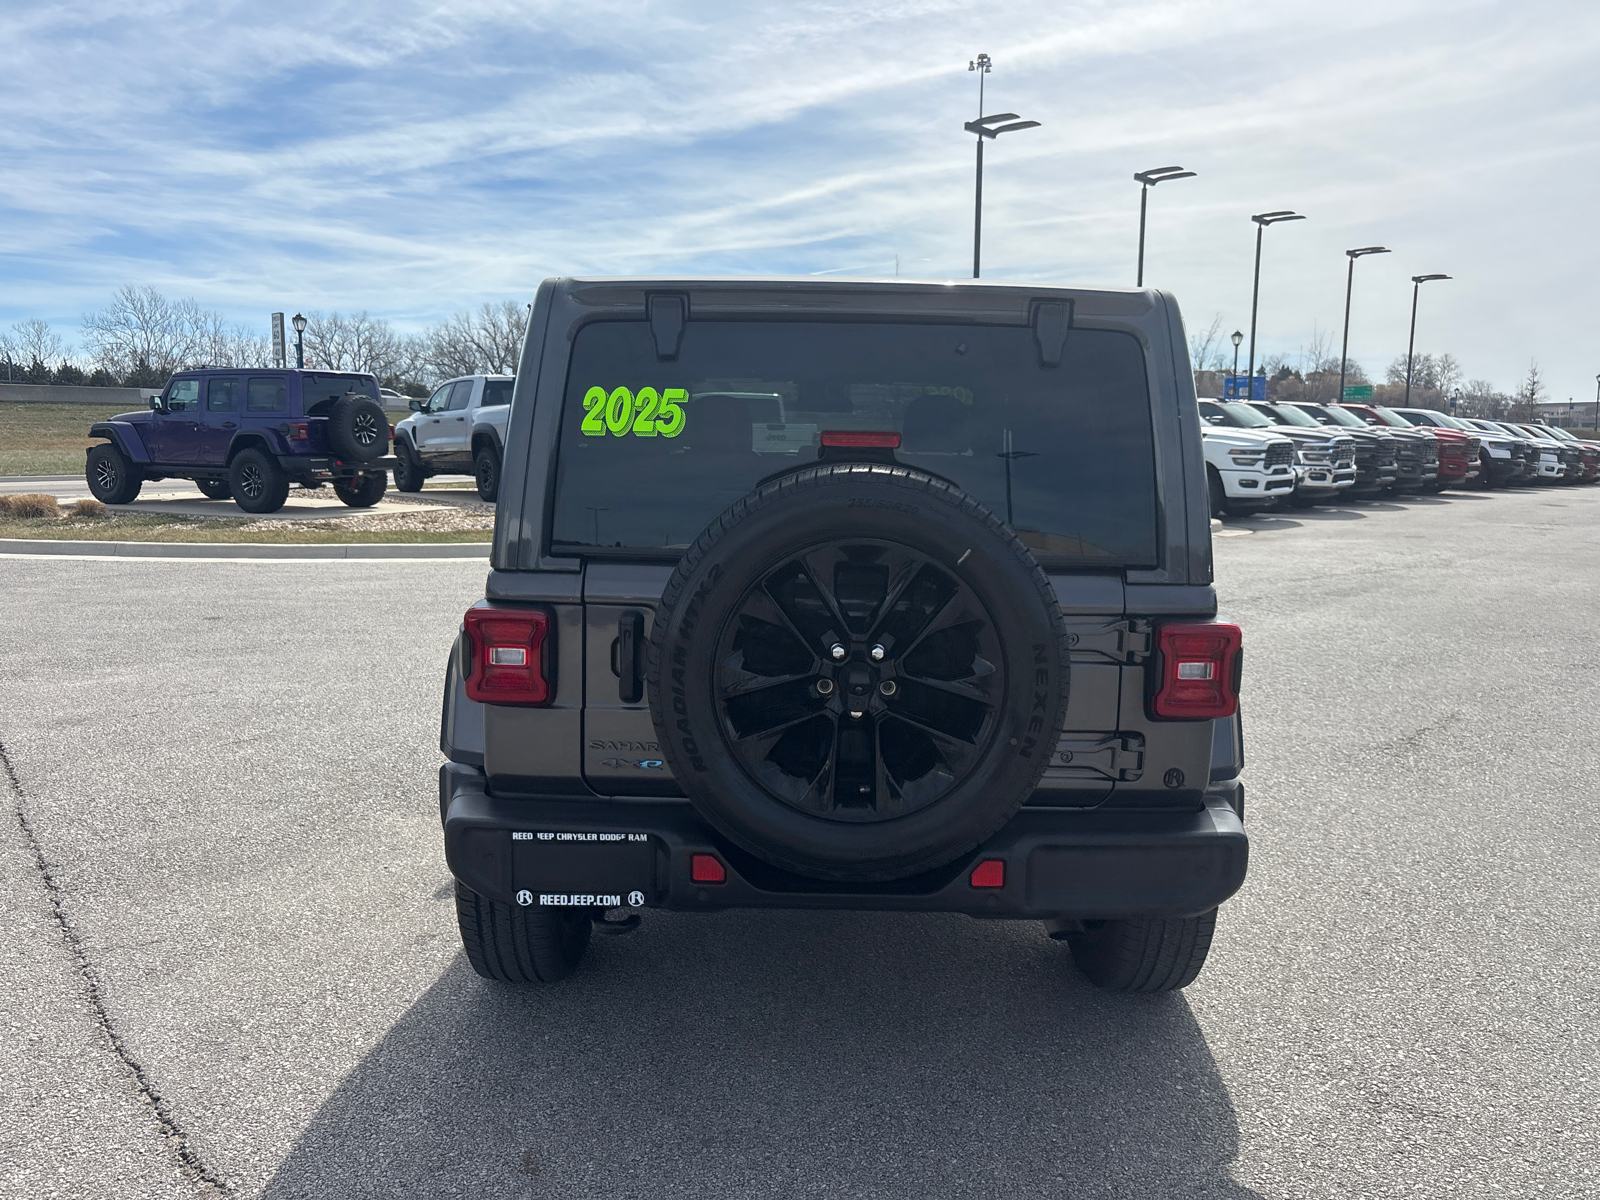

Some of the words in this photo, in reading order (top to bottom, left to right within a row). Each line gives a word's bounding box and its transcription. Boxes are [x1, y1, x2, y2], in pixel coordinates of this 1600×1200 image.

[581, 386, 689, 438] 2025
[671, 644, 708, 773] ROADIAN
[1019, 643, 1049, 758] NEXEN
[589, 740, 660, 752] SAHAR
[512, 832, 533, 840] REED
[556, 832, 598, 841] CHRYSLER
[628, 833, 648, 842] RAM
[539, 894, 621, 906] REEDJEEP.COM
